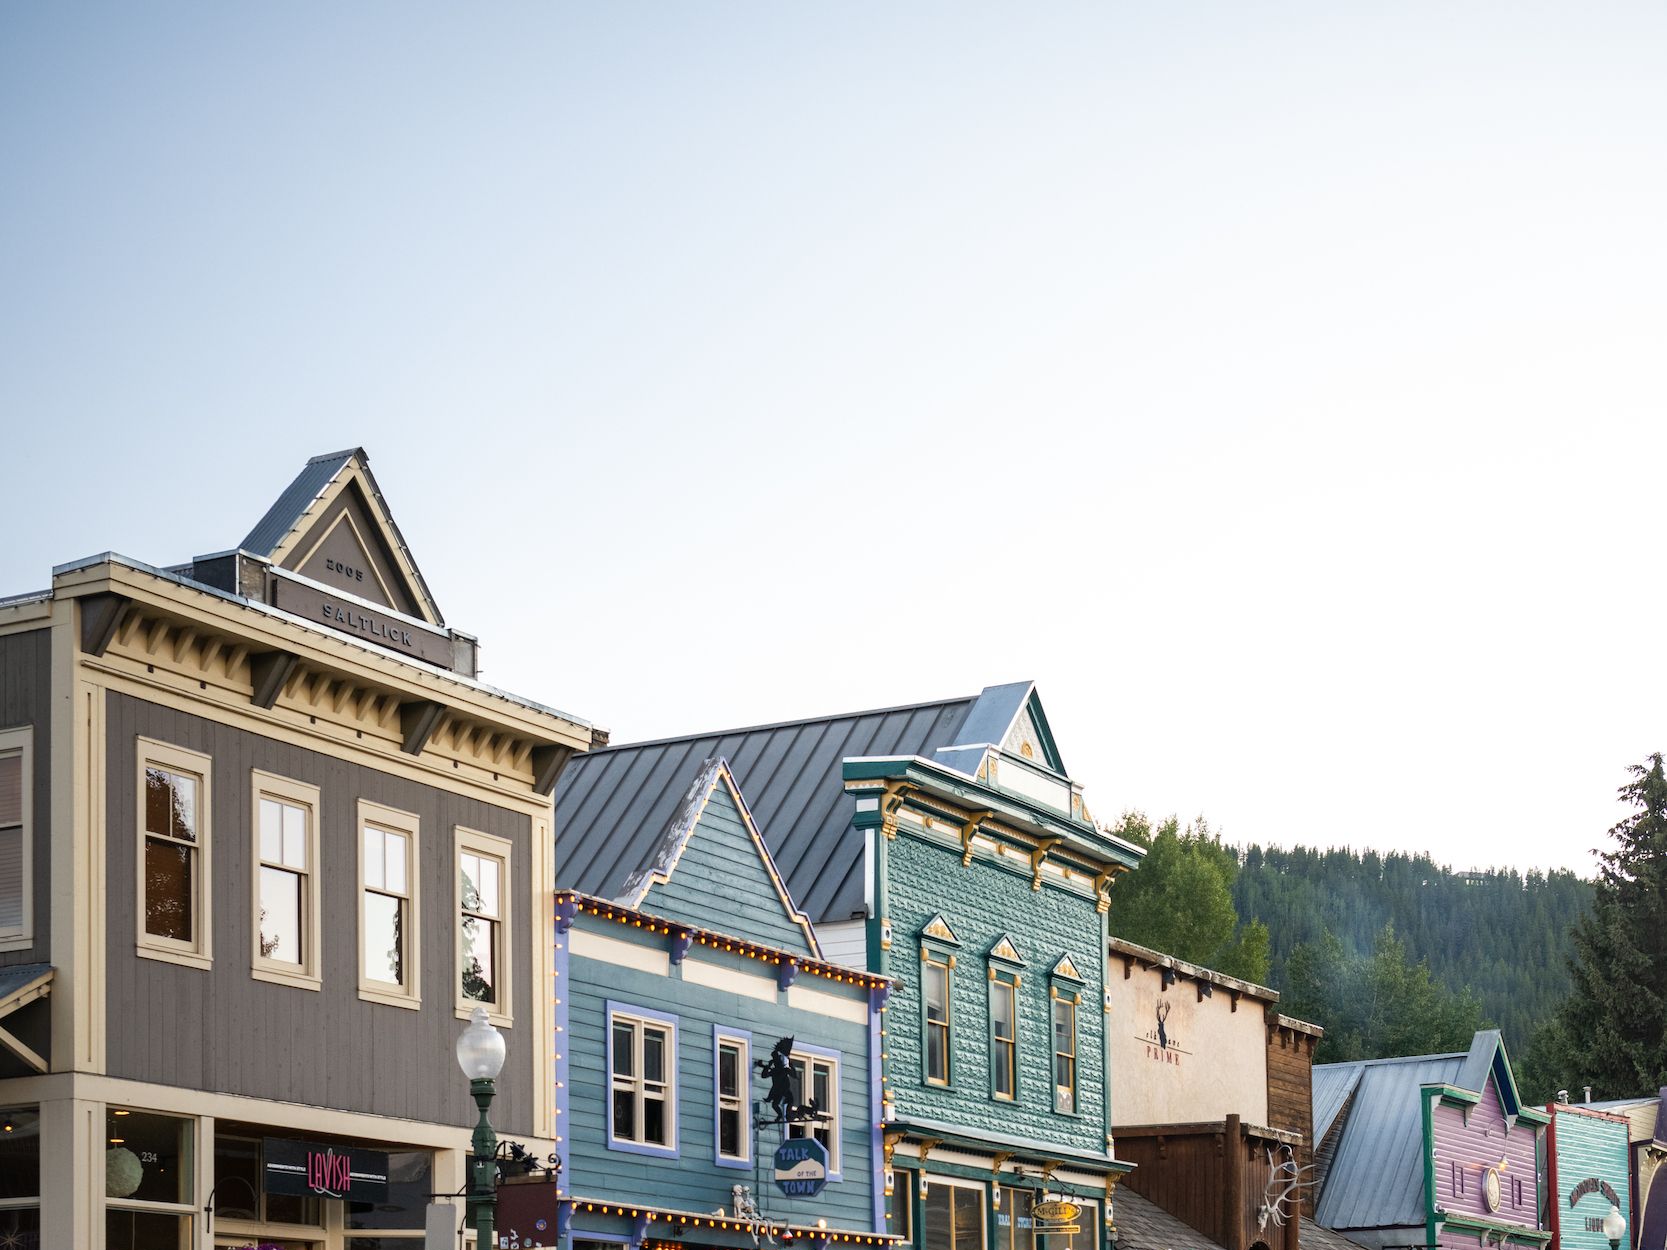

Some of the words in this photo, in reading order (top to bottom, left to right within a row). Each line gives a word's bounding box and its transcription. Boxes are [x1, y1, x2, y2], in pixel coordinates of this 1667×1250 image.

[326, 559, 364, 582] 2005
[323, 603, 412, 647] SALTLICK
[1147, 1045, 1180, 1066] PRIME
[141, 1151, 158, 1163] 234
[780, 1148, 809, 1161] TALK
[308, 1151, 351, 1192] LAVISH
[783, 1181, 816, 1194] TOWN
